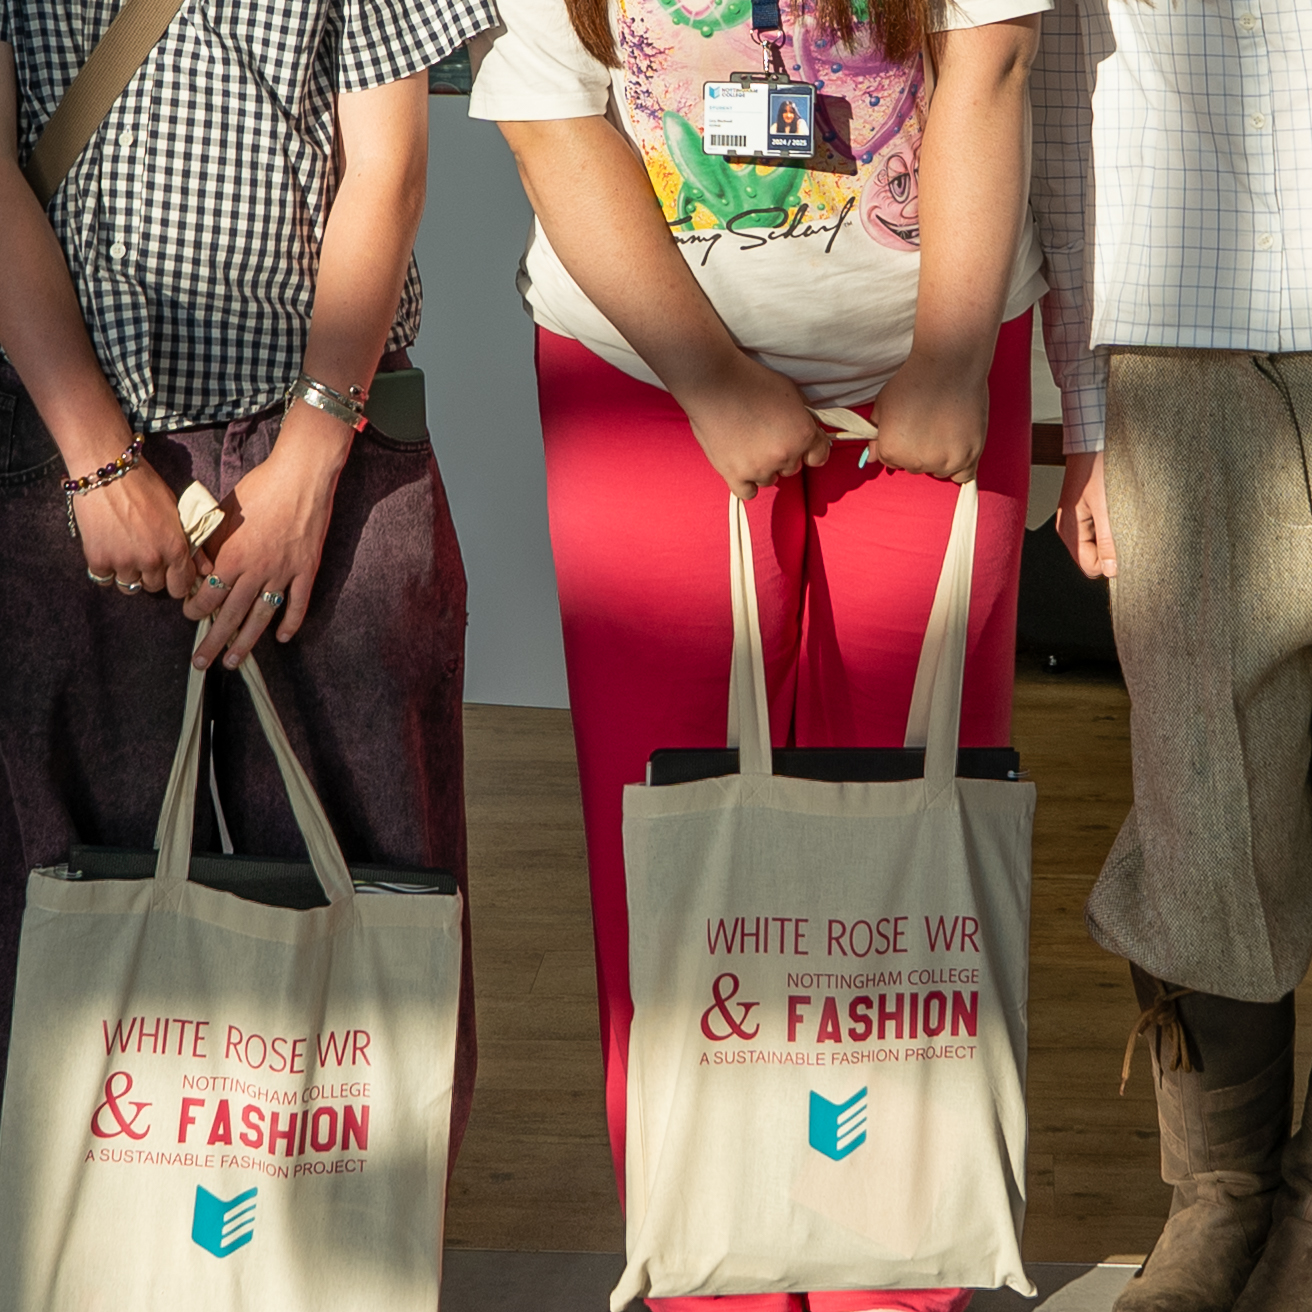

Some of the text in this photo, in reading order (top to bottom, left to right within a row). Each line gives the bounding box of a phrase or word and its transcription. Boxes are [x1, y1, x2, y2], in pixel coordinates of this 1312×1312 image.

[707, 915, 981, 958] WHITE ROSE WR
[786, 968, 980, 989] NOTTINGHAM COLLEGE
[700, 972, 979, 1044] & FASHION
[101, 1016, 372, 1075] WHITE ROSE WR
[699, 1044, 977, 1066] A SUSTAINABLE FASHION PROJECT
[182, 1074, 371, 1106] NOTTINGHAM COLLEGE
[89, 1070, 371, 1158] & FASHION
[84, 1148, 368, 1180] A SUSTAINABLE FASHION PROJECT
